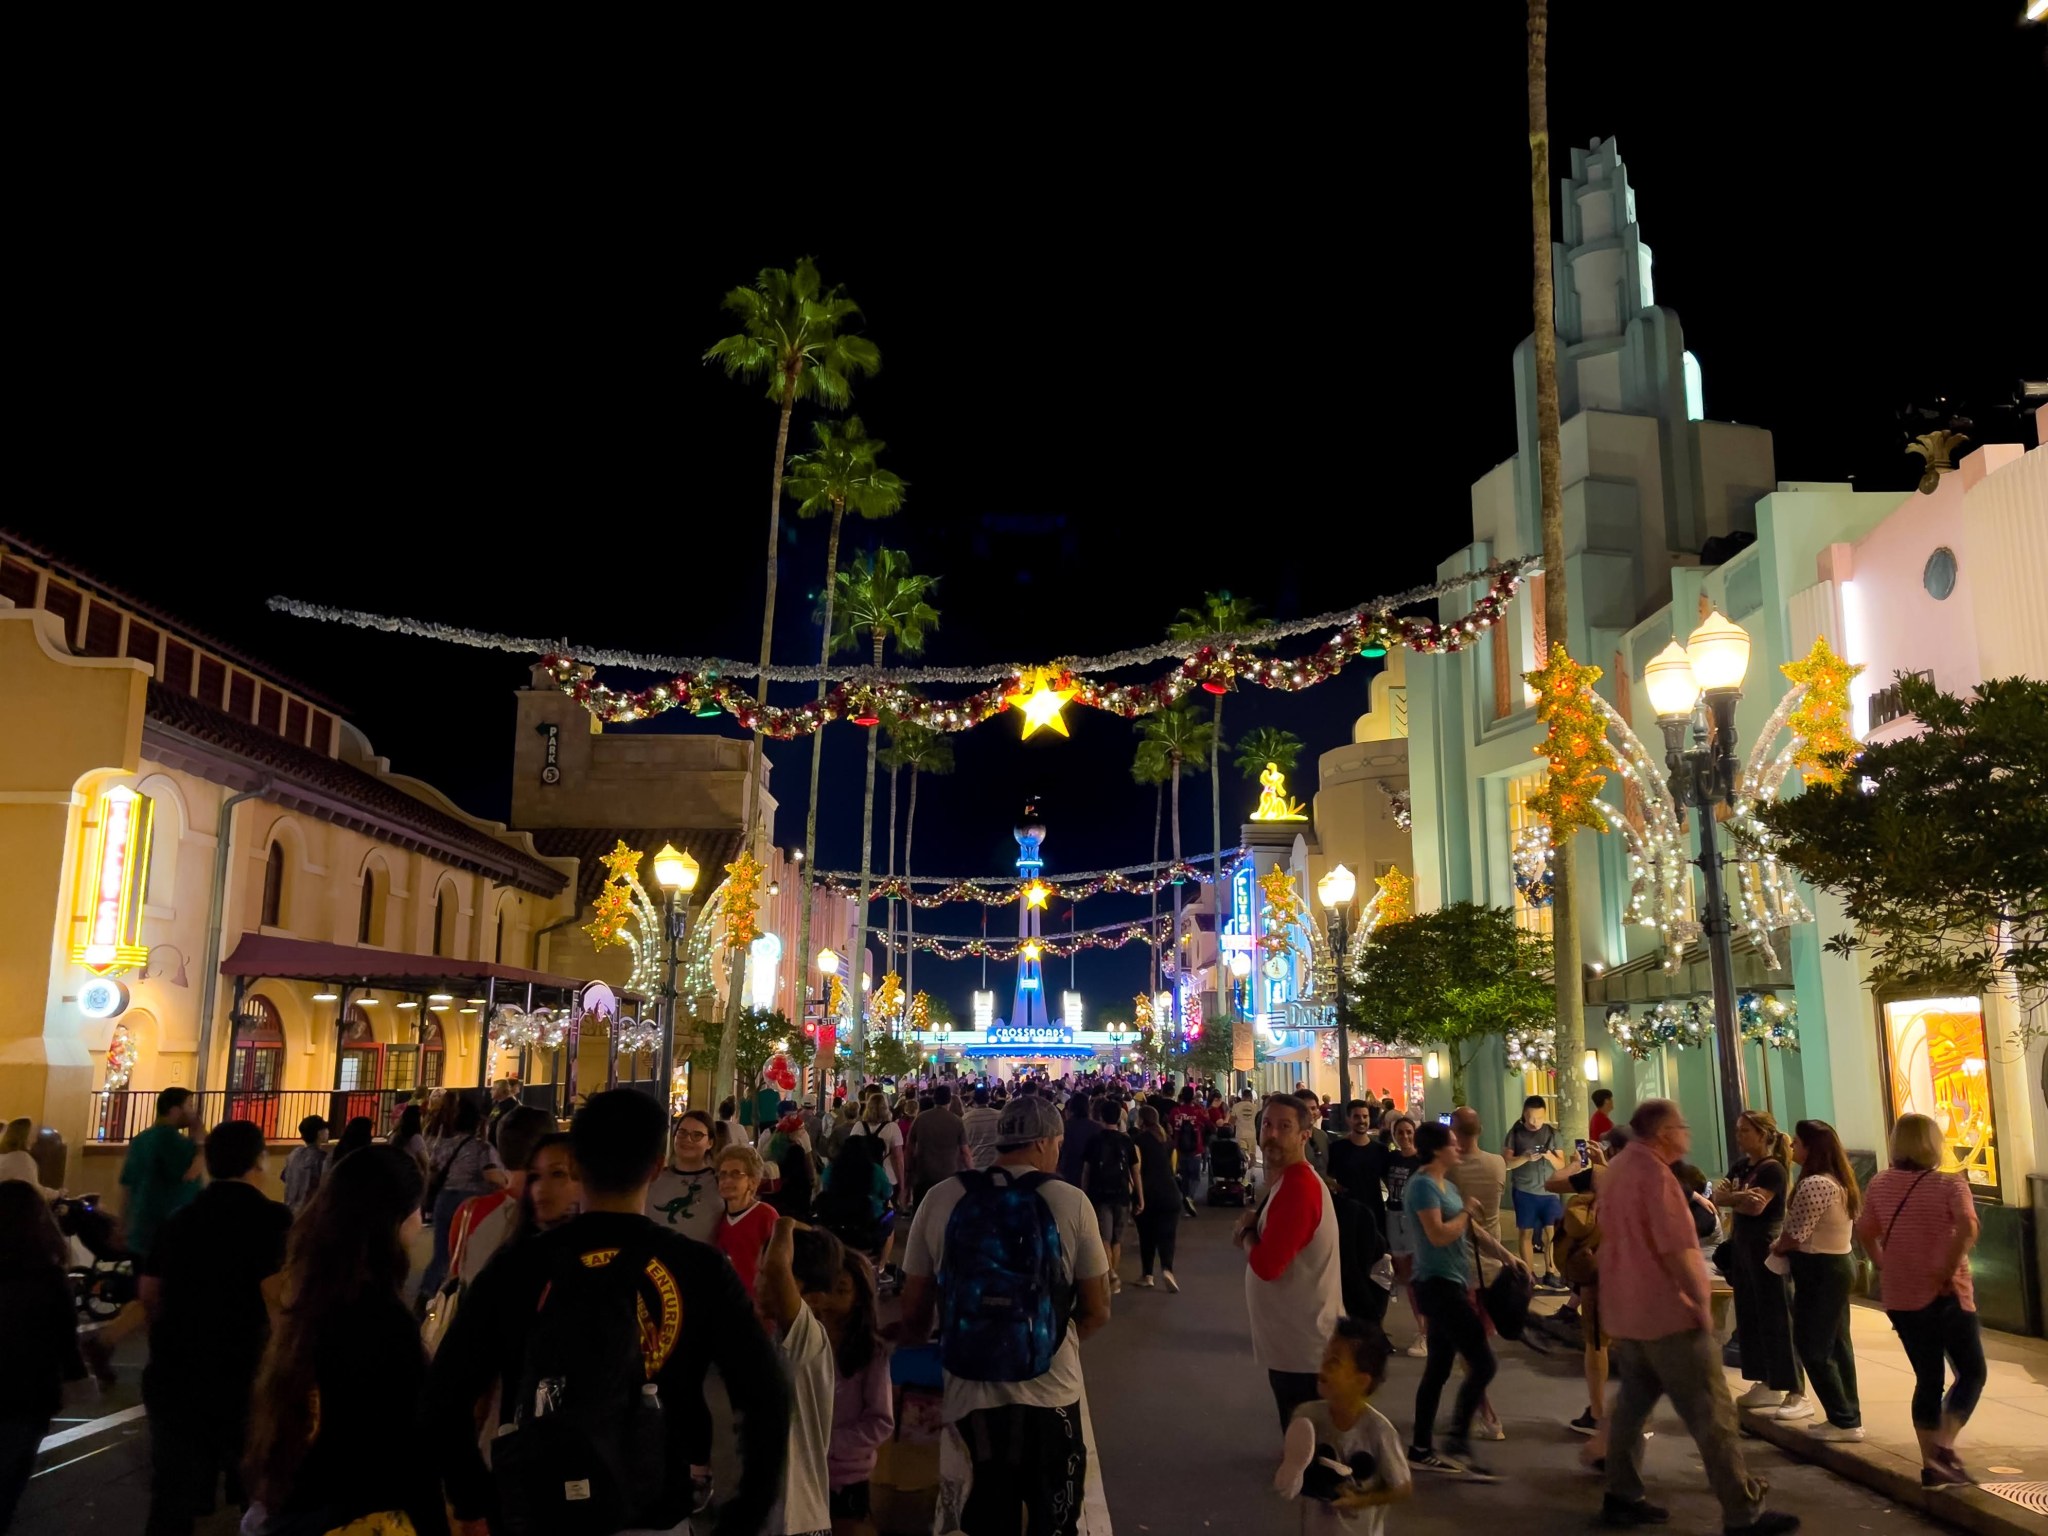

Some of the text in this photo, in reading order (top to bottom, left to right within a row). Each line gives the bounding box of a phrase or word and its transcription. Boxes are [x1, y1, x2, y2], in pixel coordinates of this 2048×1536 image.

[547, 726, 558, 764] PARK
[822, 1017, 841, 1026] STOP
[996, 1028, 1065, 1037] CROSSROADS
